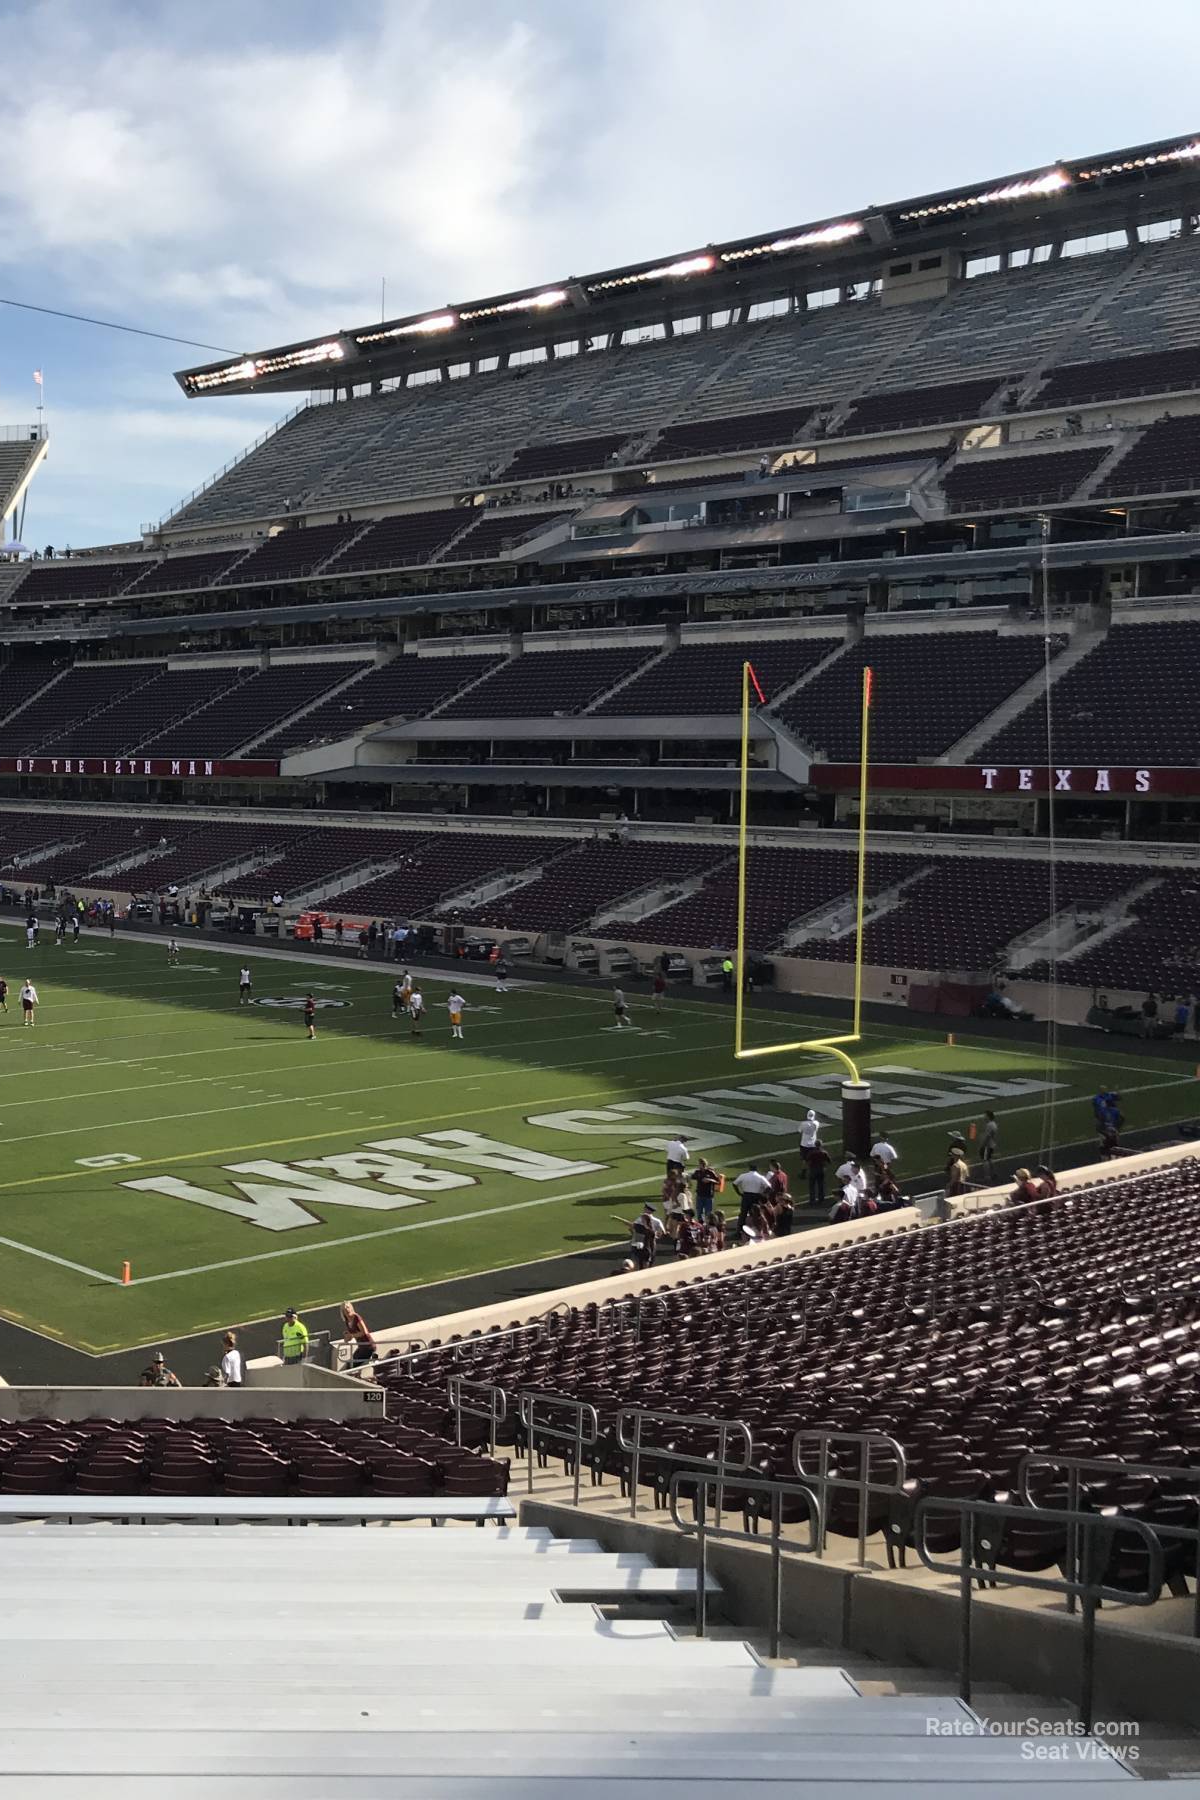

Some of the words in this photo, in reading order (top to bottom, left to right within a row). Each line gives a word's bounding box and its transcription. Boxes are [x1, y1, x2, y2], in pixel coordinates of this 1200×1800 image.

[17, 759, 34, 773] OF
[52, 760, 85, 773] THE
[103, 760, 151, 774] 12TH
[172, 761, 213, 775] MAN
[981, 768, 1151, 793] TEXAS
[366, 1392, 382, 1401] 120
